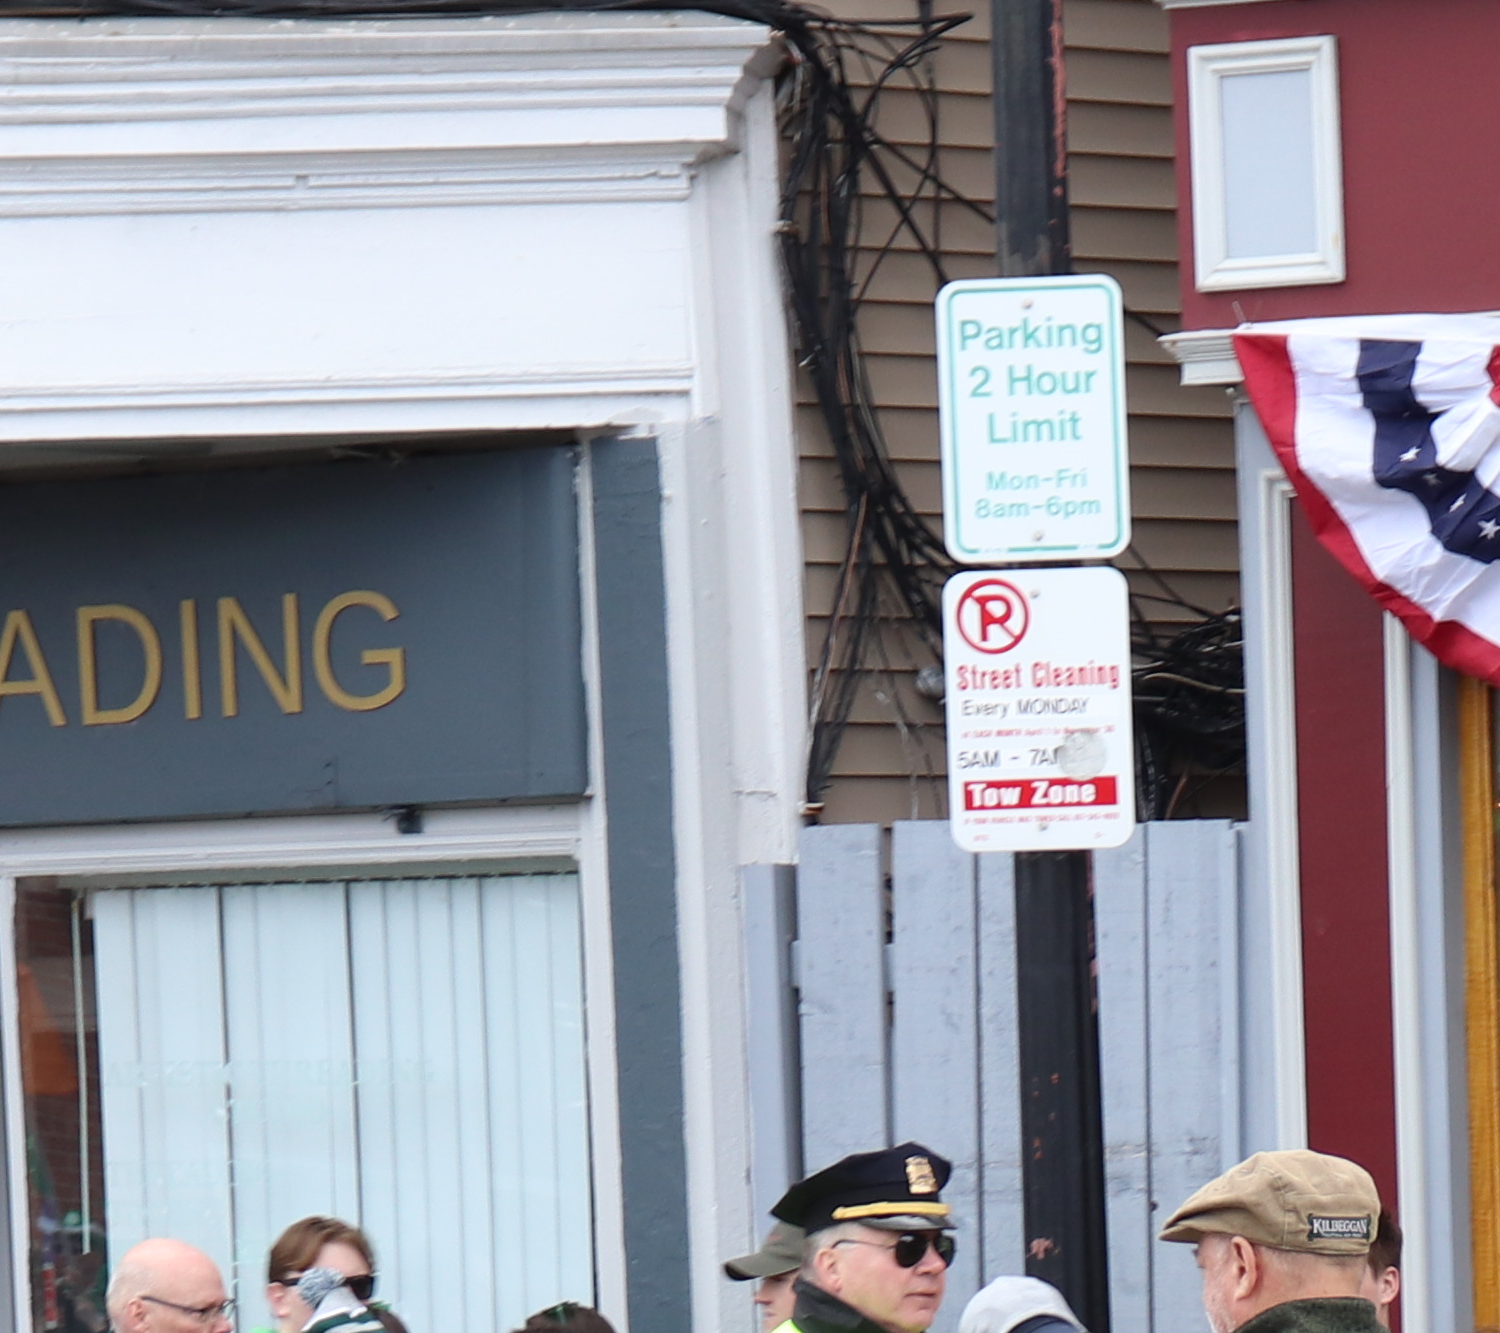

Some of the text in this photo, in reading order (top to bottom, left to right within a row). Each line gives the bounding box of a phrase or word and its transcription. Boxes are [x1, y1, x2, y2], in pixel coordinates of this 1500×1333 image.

[959, 317, 1103, 354] Parking
[969, 364, 1097, 397] 2 Hour
[988, 410, 1082, 444] Limit
[985, 467, 1089, 491] Mon-Fri
[975, 496, 1101, 519] 8am-6pm
[956, 659, 1120, 691] Street Cleaning
[962, 697, 1090, 719] Every MONDAY
[957, 749, 1001, 769] 5AM
[967, 780, 1097, 808] Tow Zone
